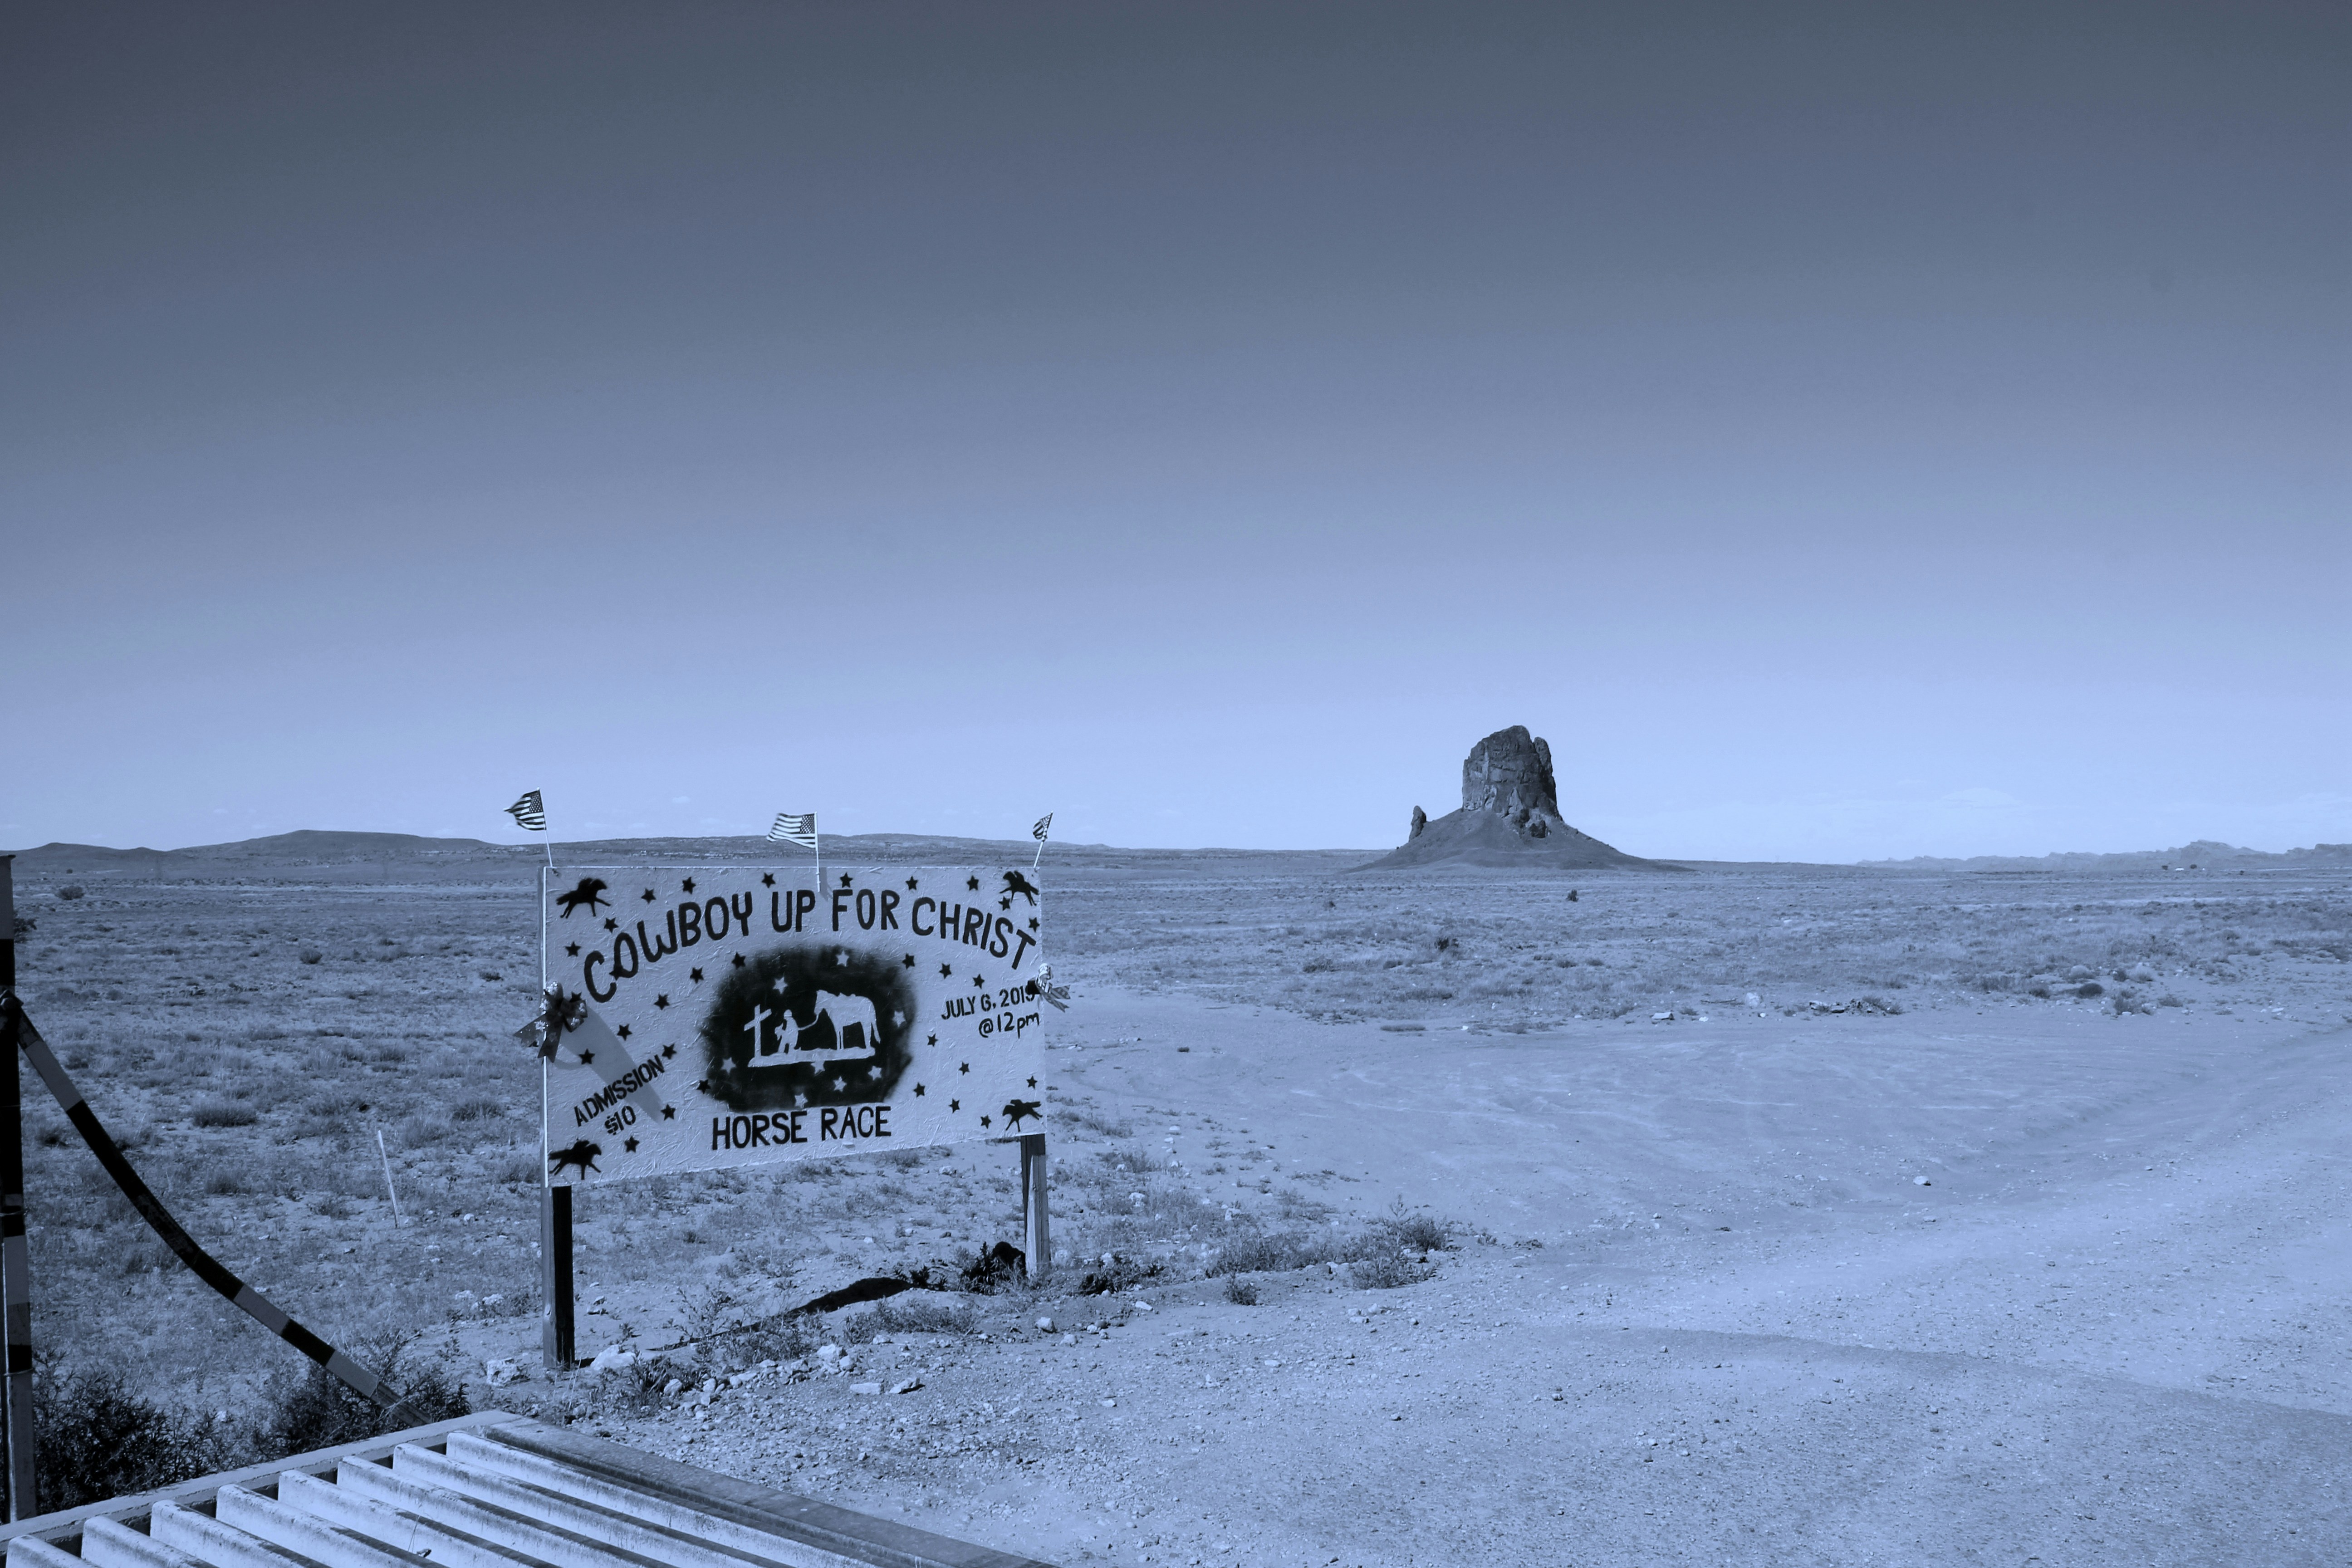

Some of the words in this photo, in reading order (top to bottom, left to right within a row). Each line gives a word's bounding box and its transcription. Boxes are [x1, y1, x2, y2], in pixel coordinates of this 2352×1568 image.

[584, 891, 753, 1003] COWBOY
[772, 890, 815, 932] UP
[833, 889, 900, 931] FOR
[912, 897, 1036, 970] CHRIST
[941, 996, 975, 1019] JULY
[574, 1054, 665, 1127] ADMISSION
[604, 1106, 636, 1136] $10
[712, 1111, 808, 1150] HORSE
[821, 1106, 892, 1141] RACE
